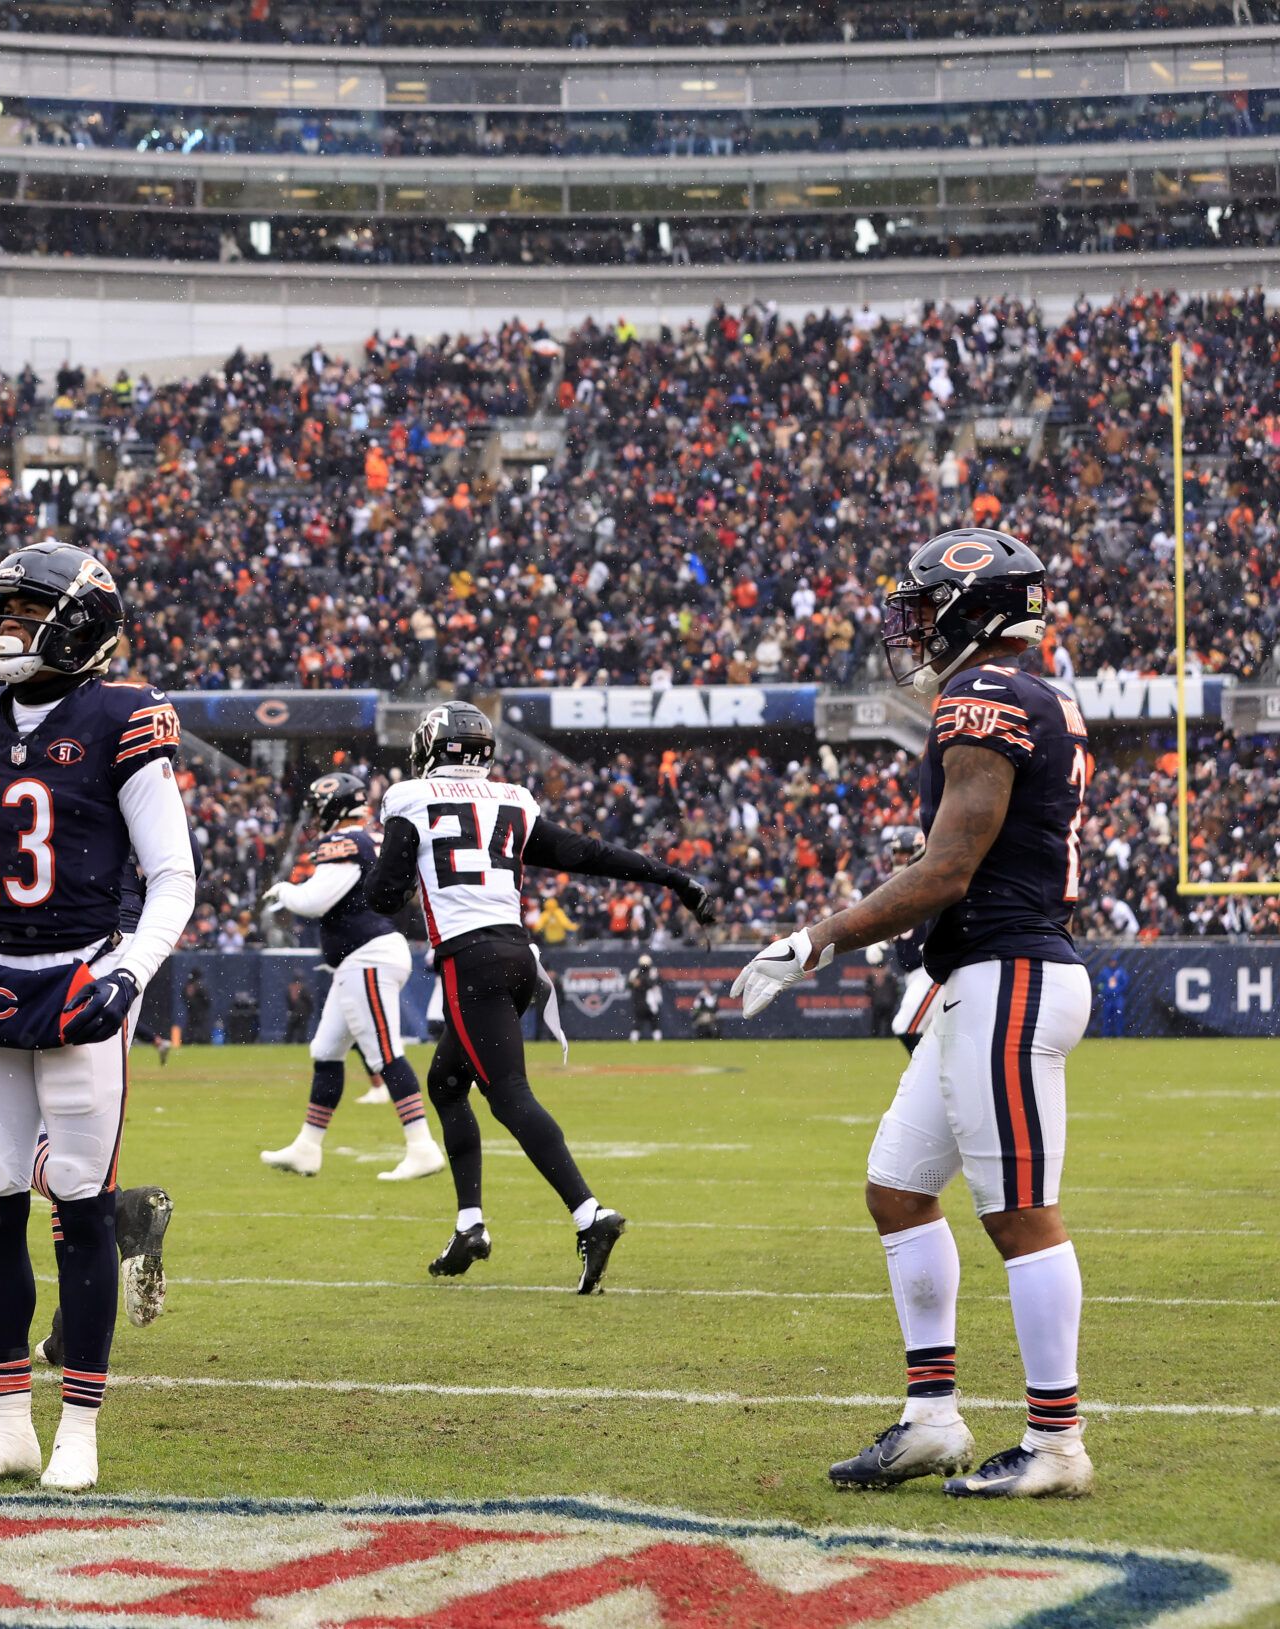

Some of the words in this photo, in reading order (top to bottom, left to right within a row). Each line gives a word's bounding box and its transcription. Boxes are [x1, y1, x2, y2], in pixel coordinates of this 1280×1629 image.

[551, 690, 766, 729] BEAR
[1050, 679, 1204, 721] WN
[954, 704, 1001, 734] GSH
[59, 747, 72, 762] 51
[462, 753, 481, 767] 24
[429, 782, 498, 800] TERRELL
[426, 802, 528, 890] 24
